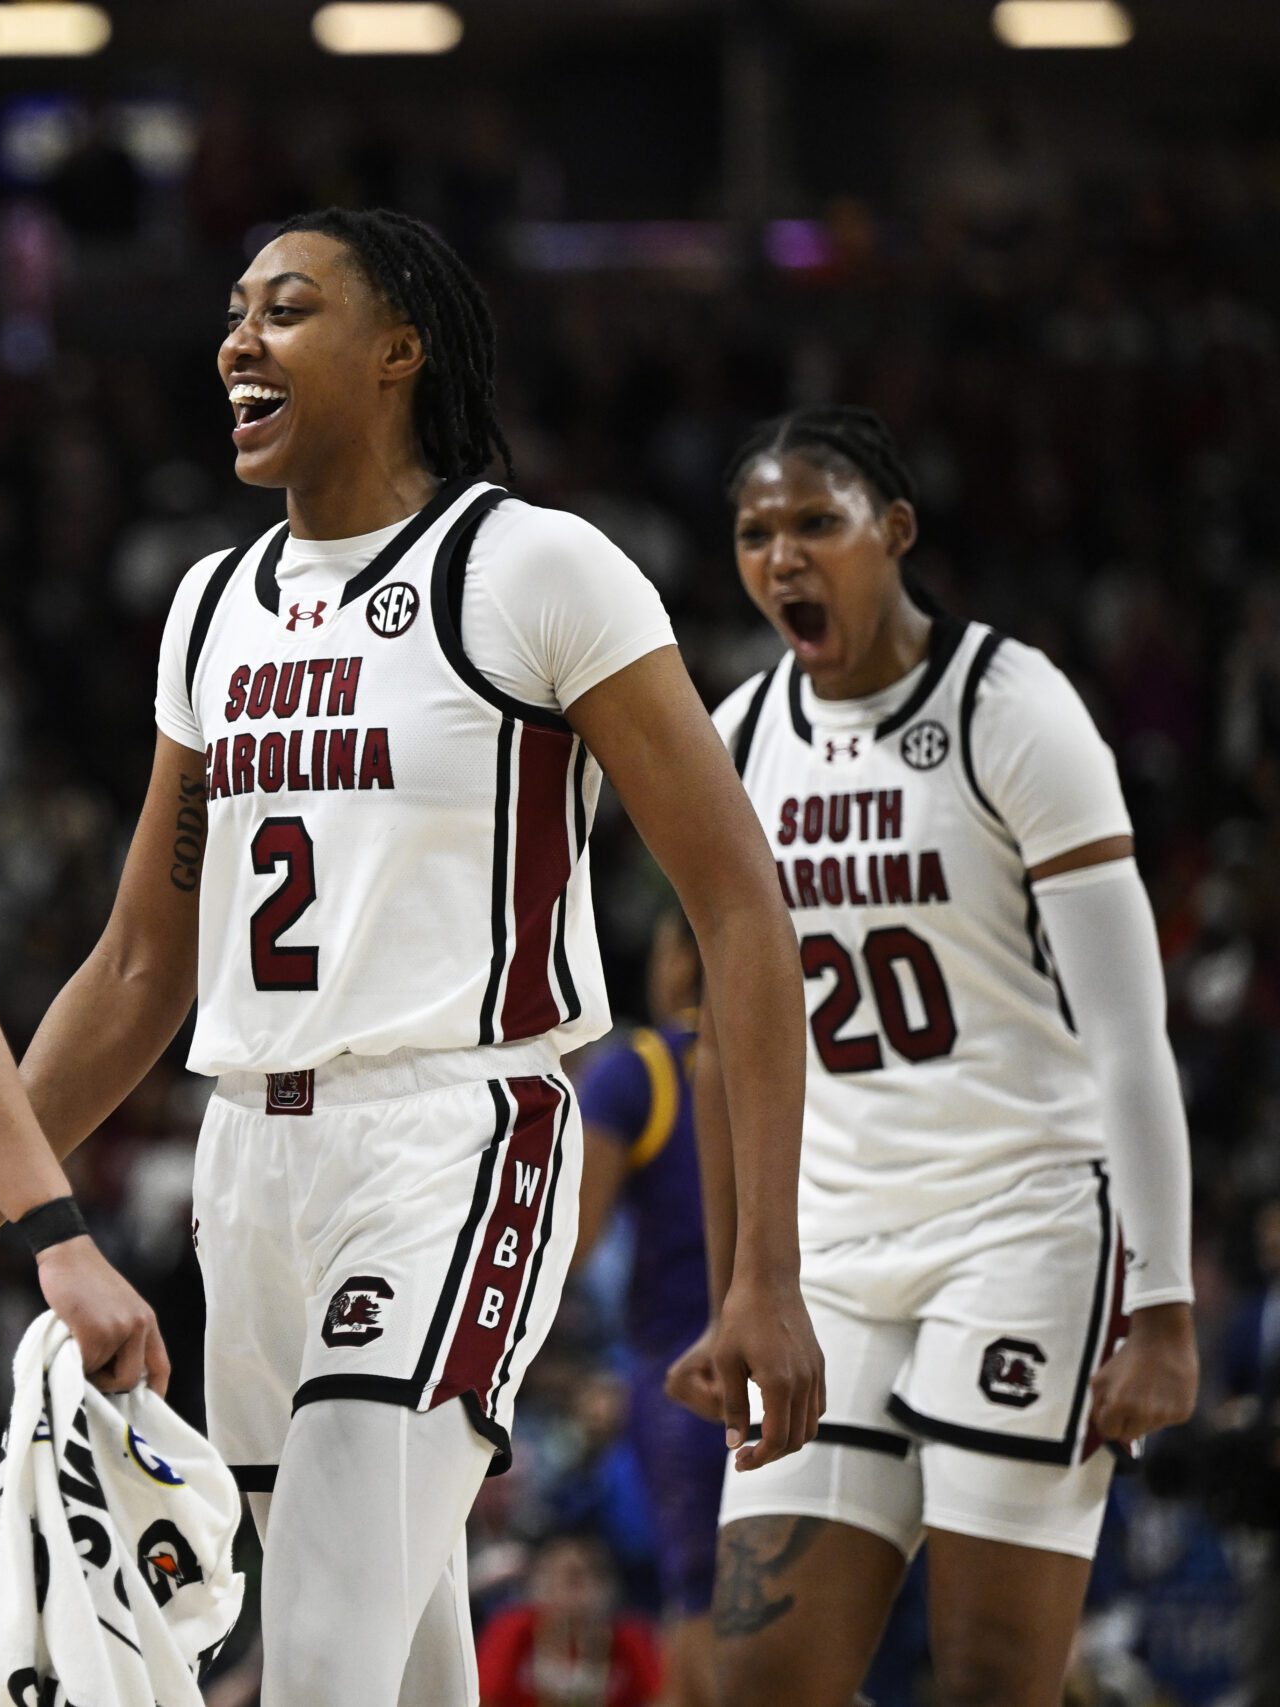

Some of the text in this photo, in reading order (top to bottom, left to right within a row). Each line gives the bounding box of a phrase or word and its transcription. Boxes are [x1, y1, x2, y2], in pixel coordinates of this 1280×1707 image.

[370, 585, 415, 634] SEC
[225, 656, 363, 723] SOUTH
[777, 789, 903, 846] SOUTH
[250, 816, 319, 992] 2
[776, 851, 950, 909] ROLINA
[800, 925, 958, 1074] 20
[476, 1160, 542, 1330] WBB
